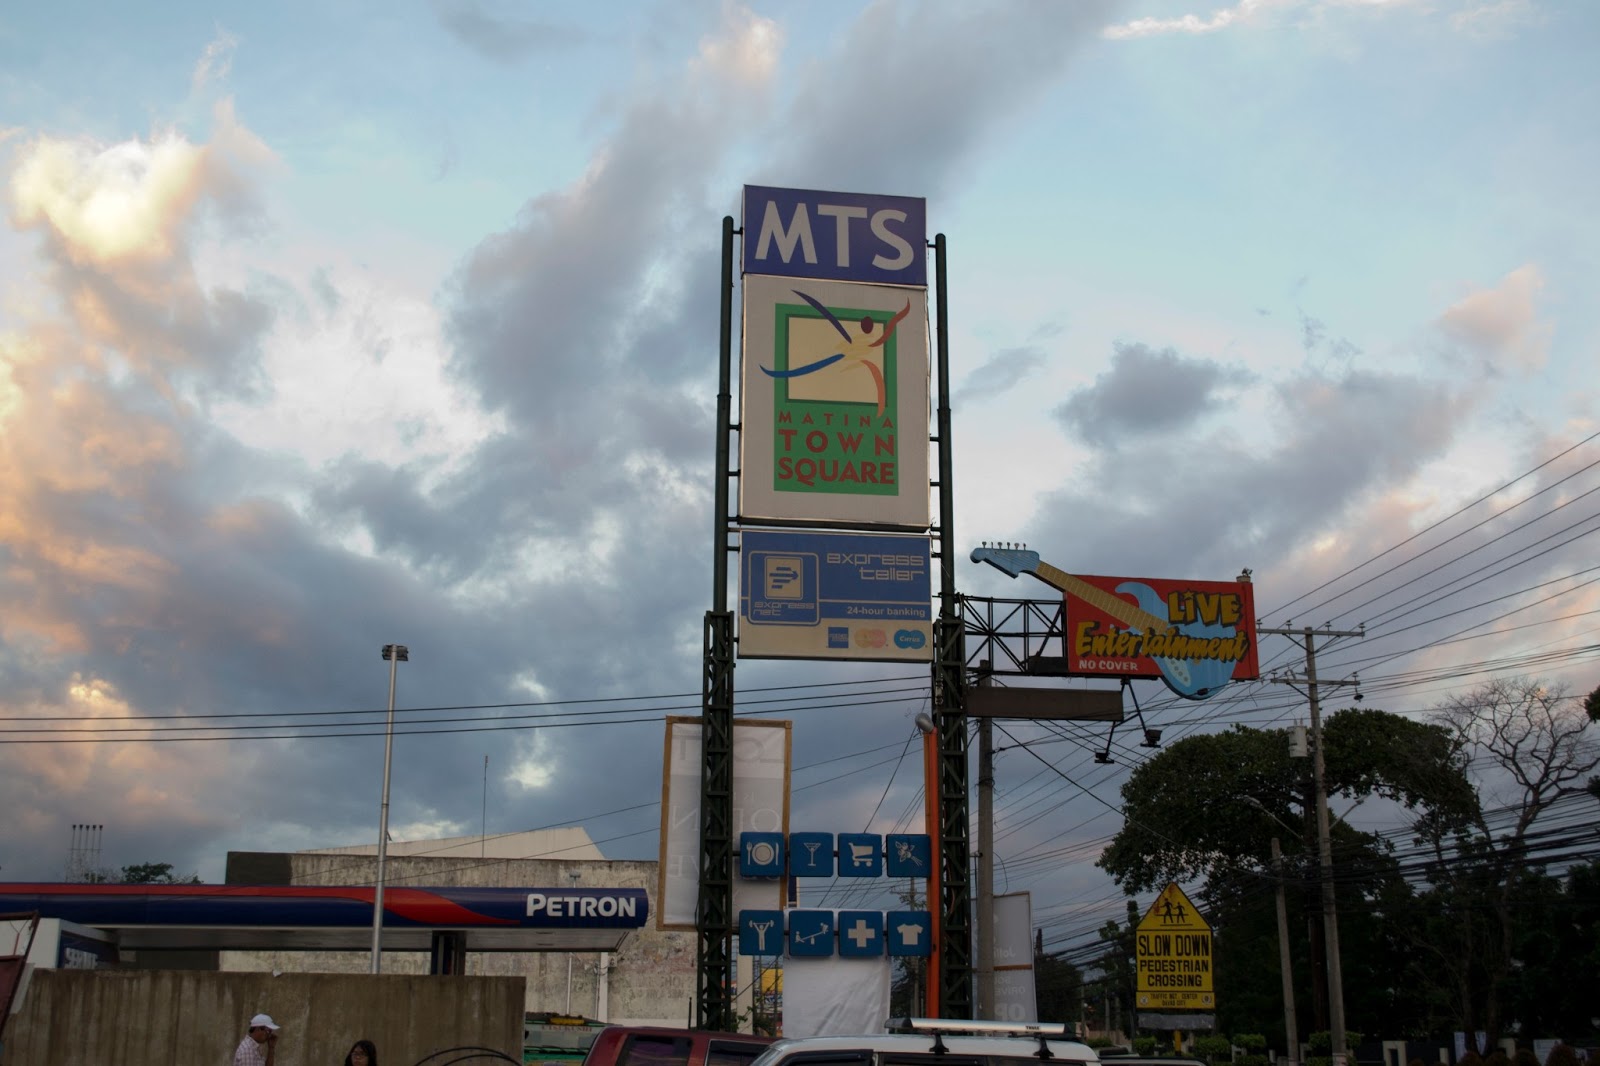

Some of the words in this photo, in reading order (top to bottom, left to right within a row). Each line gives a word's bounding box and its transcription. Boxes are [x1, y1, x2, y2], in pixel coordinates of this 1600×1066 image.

[755, 200, 914, 271] MTS
[778, 410, 894, 429] MATINA
[778, 429, 895, 457] TOWN
[778, 457, 895, 487] SQUARE
[826, 552, 925, 567] express
[859, 567, 925, 581] teller
[753, 608, 782, 617] net
[754, 601, 815, 610] express
[847, 606, 884, 616] 24-hour
[887, 607, 926, 618] banking
[899, 635, 921, 643] Cirrus
[1075, 621, 1248, 663] Entertainment
[1079, 660, 1096, 670] NO
[1099, 660, 1138, 671] COVER
[526, 893, 636, 917] PETRON
[1138, 935, 1171, 956] SLOW
[1175, 935, 1209, 957] DOWN
[1140, 960, 1209, 972] PEDESTRIAN
[1147, 974, 1203, 987] CROSSING
